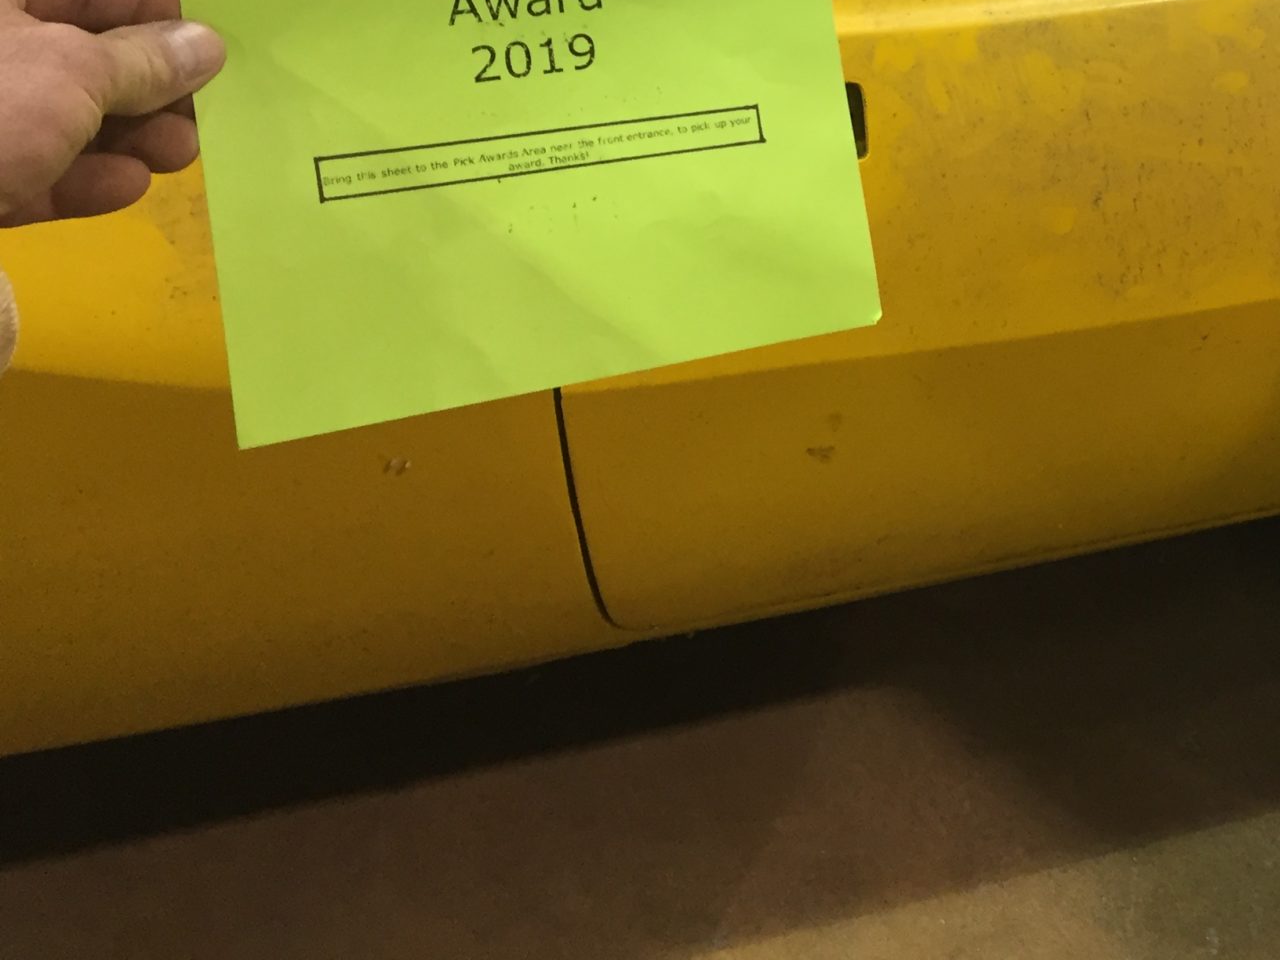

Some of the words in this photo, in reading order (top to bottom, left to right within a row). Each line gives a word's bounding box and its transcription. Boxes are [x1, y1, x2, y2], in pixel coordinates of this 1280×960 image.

[470, 33, 596, 83] 2019
[323, 175, 352, 186] Bring
[357, 172, 376, 181] this
[382, 166, 411, 178] sheet
[416, 165, 427, 173] to
[430, 161, 448, 170] the
[454, 157, 474, 167] Pick
[480, 150, 519, 163] Awards
[522, 147, 547, 156] Area
[550, 143, 572, 152] near
[578, 139, 594, 148] the
[598, 134, 624, 145] front
[627, 128, 674, 141] entrance,
[678, 126, 688, 134] to
[691, 122, 710, 133] pick
[715, 120, 726, 130] up
[730, 117, 751, 127] your
[549, 152, 589, 164] Thanks!
